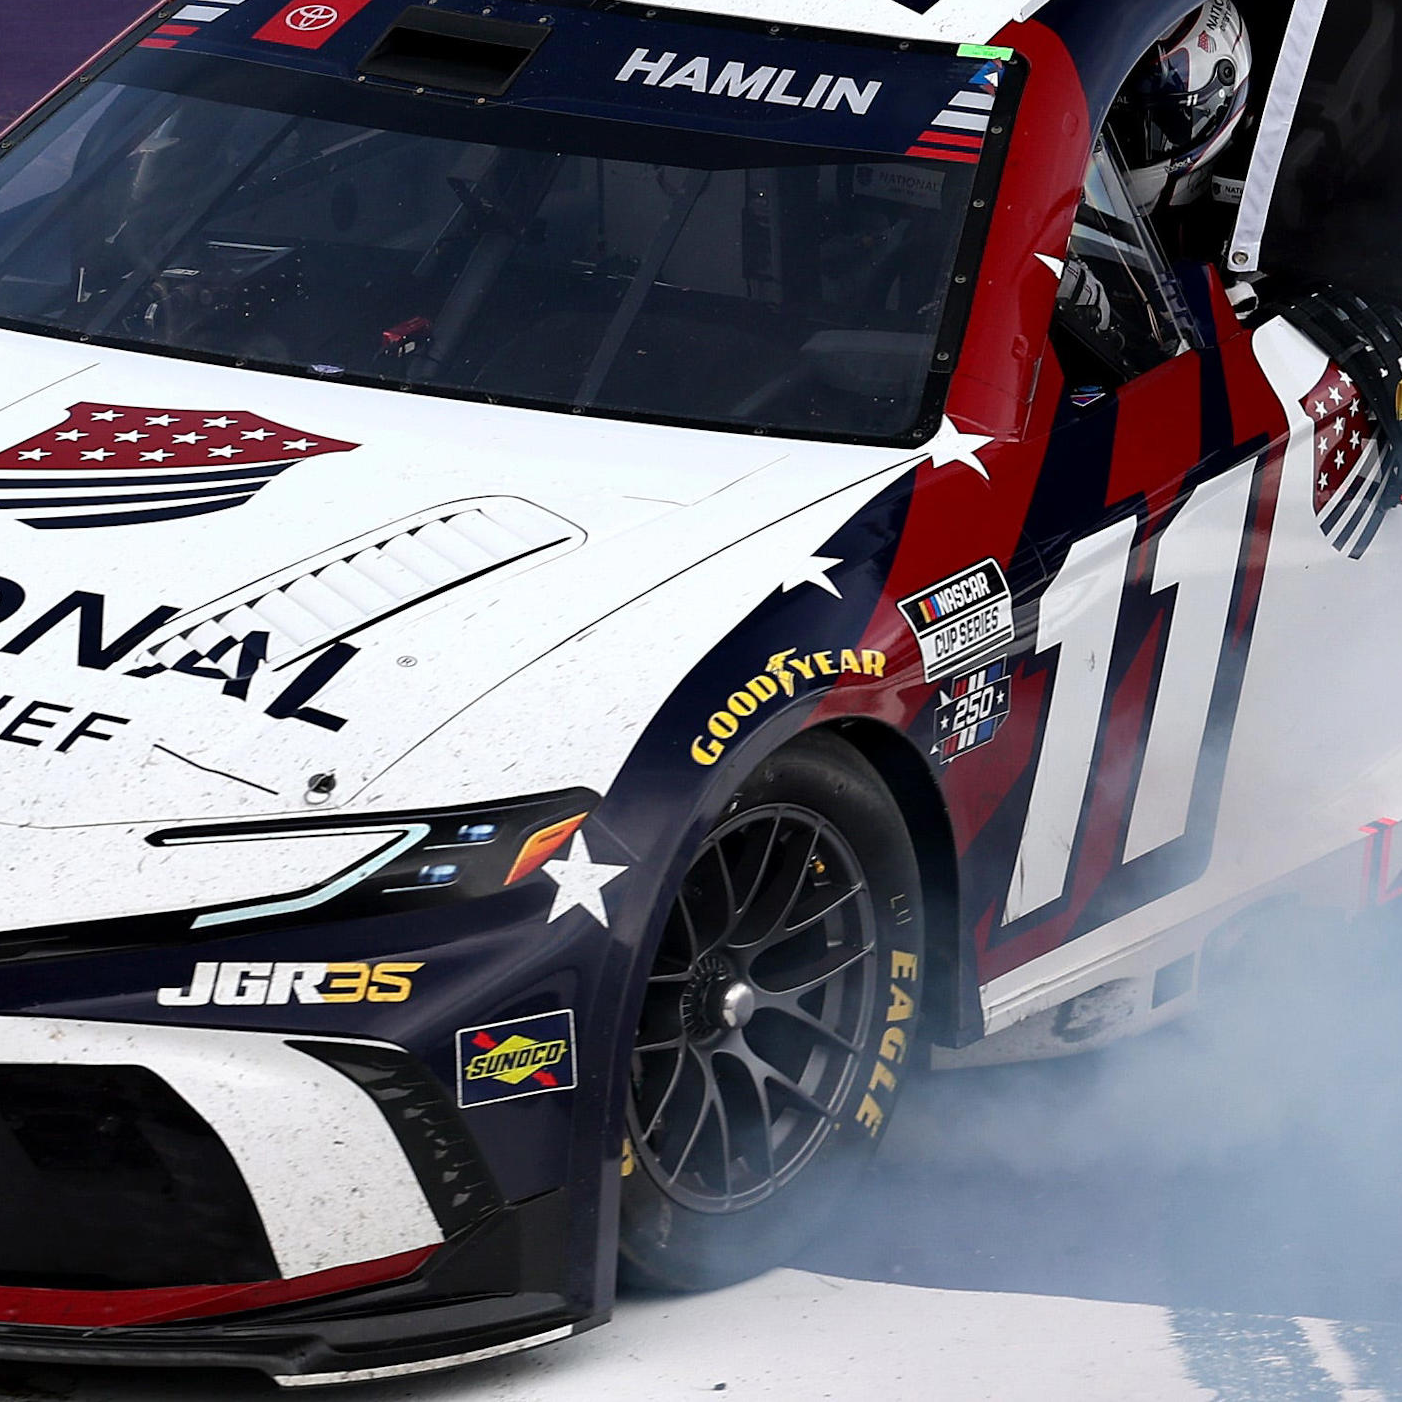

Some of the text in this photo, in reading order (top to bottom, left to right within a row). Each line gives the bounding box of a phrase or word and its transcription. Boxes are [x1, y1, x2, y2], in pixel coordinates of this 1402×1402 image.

[614, 47, 883, 116] HAMLIN
[934, 571, 991, 616] NASCAR
[934, 605, 999, 658] CUP SERIES
[690, 648, 887, 766] GOODYEAR
[951, 685, 995, 733] 250
[1000, 455, 1258, 927] 11
[470, 1042, 563, 1078] SUNOCO
[854, 949, 918, 1139] EAGLE
